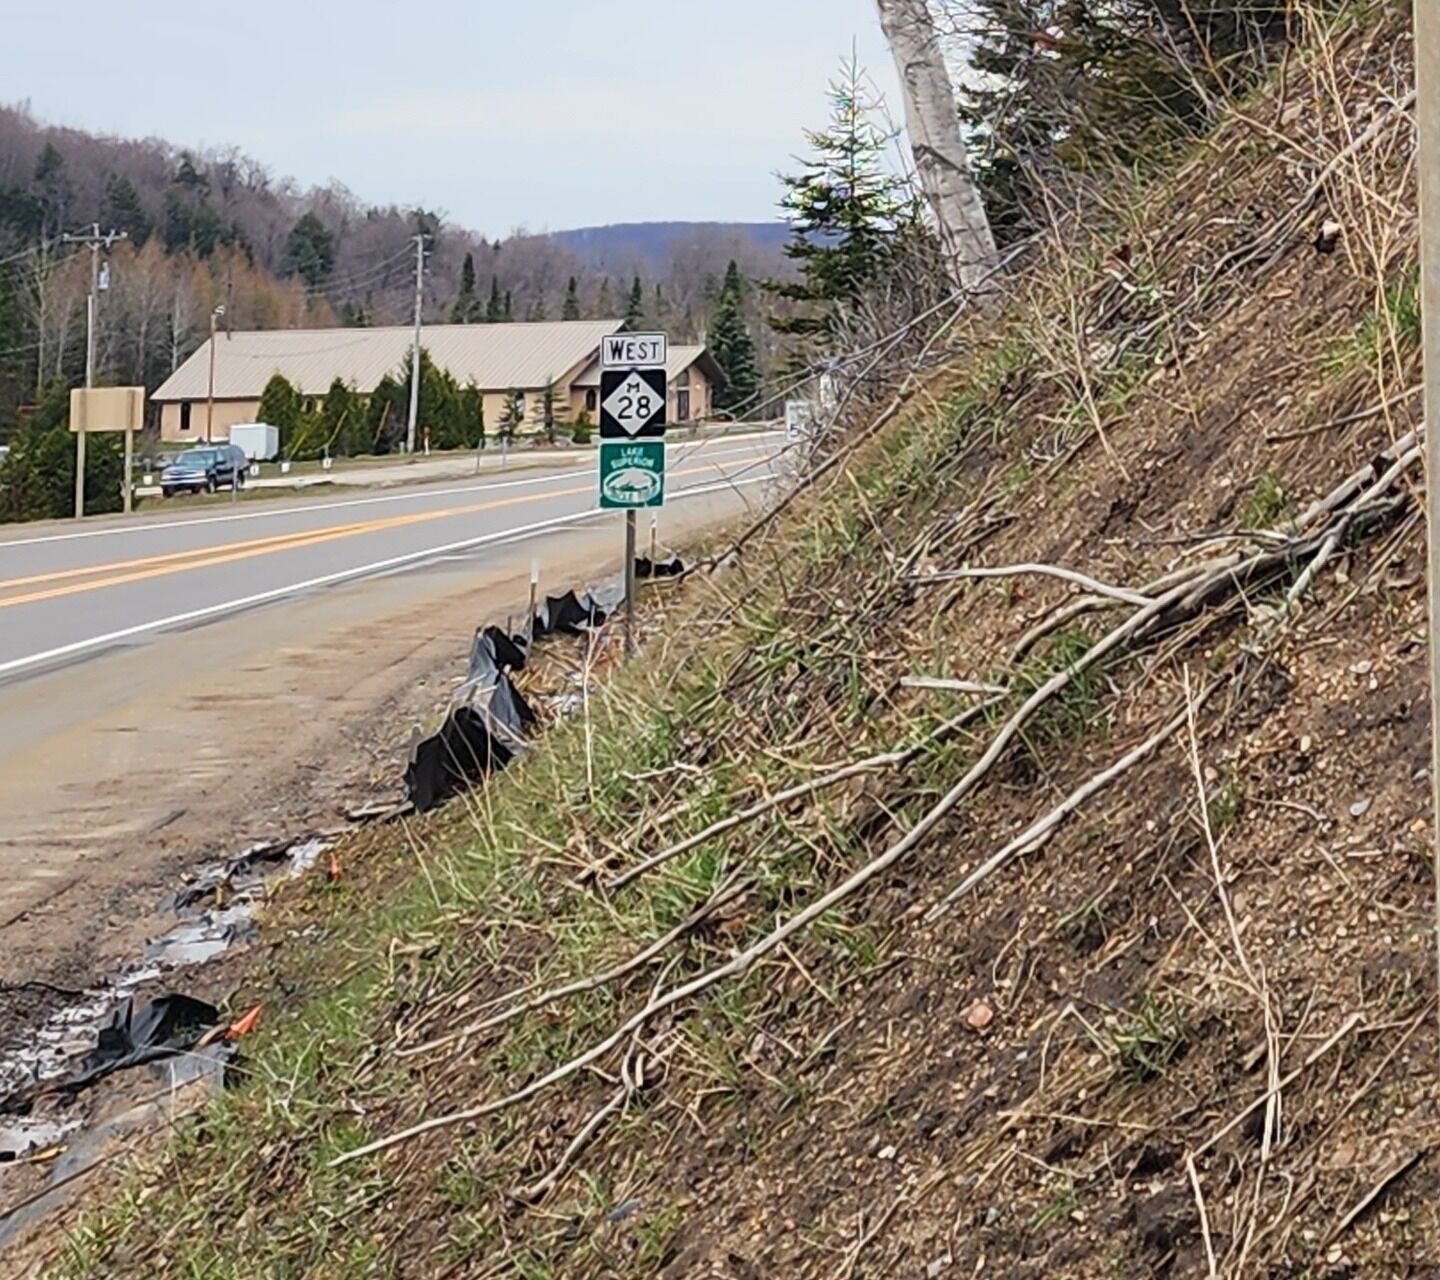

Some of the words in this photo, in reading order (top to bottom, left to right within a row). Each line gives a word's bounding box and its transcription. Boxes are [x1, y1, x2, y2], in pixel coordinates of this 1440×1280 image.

[609, 339, 660, 361] WEST
[626, 382, 641, 393] M
[617, 395, 651, 420] 28
[620, 446, 644, 457] LAKE
[610, 457, 655, 469] SUPERIOR
